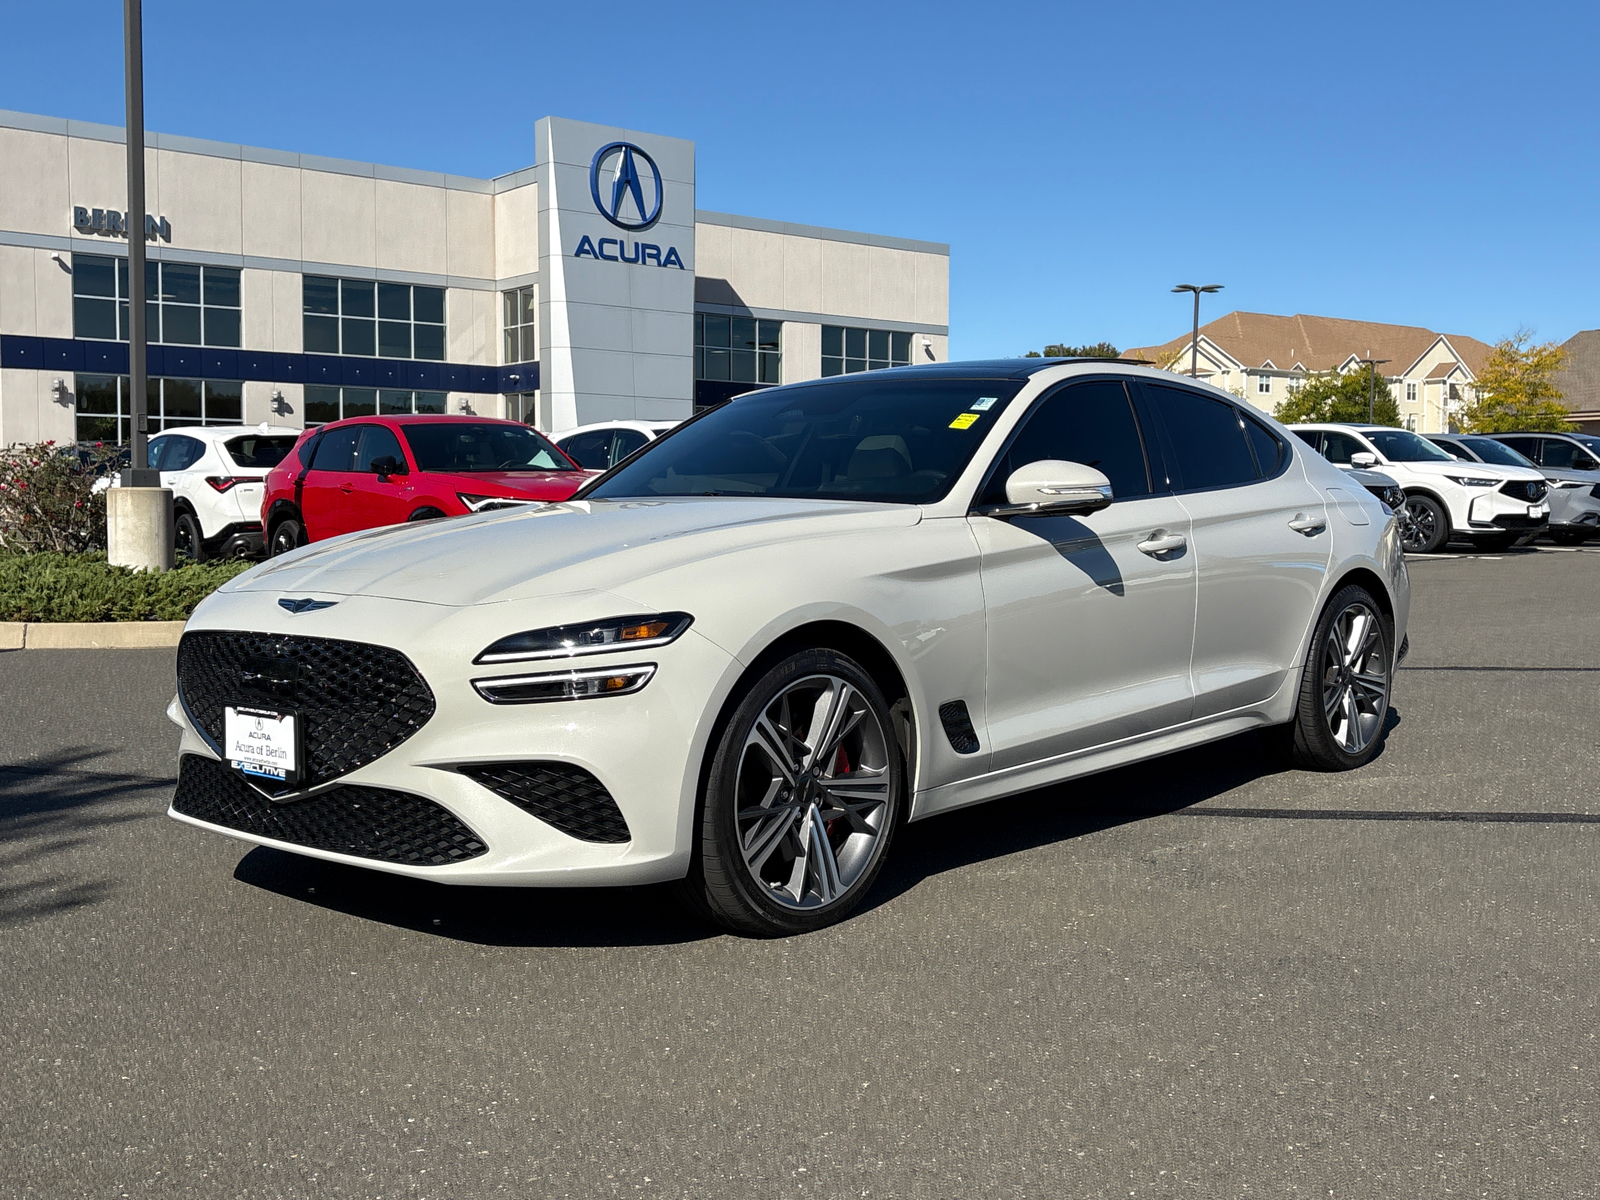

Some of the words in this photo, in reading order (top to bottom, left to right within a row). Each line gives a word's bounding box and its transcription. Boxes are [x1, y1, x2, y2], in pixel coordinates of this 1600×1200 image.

[73, 205, 168, 237] BERN
[574, 234, 685, 270] ACURA
[248, 731, 272, 741] ACURA
[235, 740, 255, 754] Acura
[256, 745, 264, 756] of
[265, 744, 288, 760] Berlin
